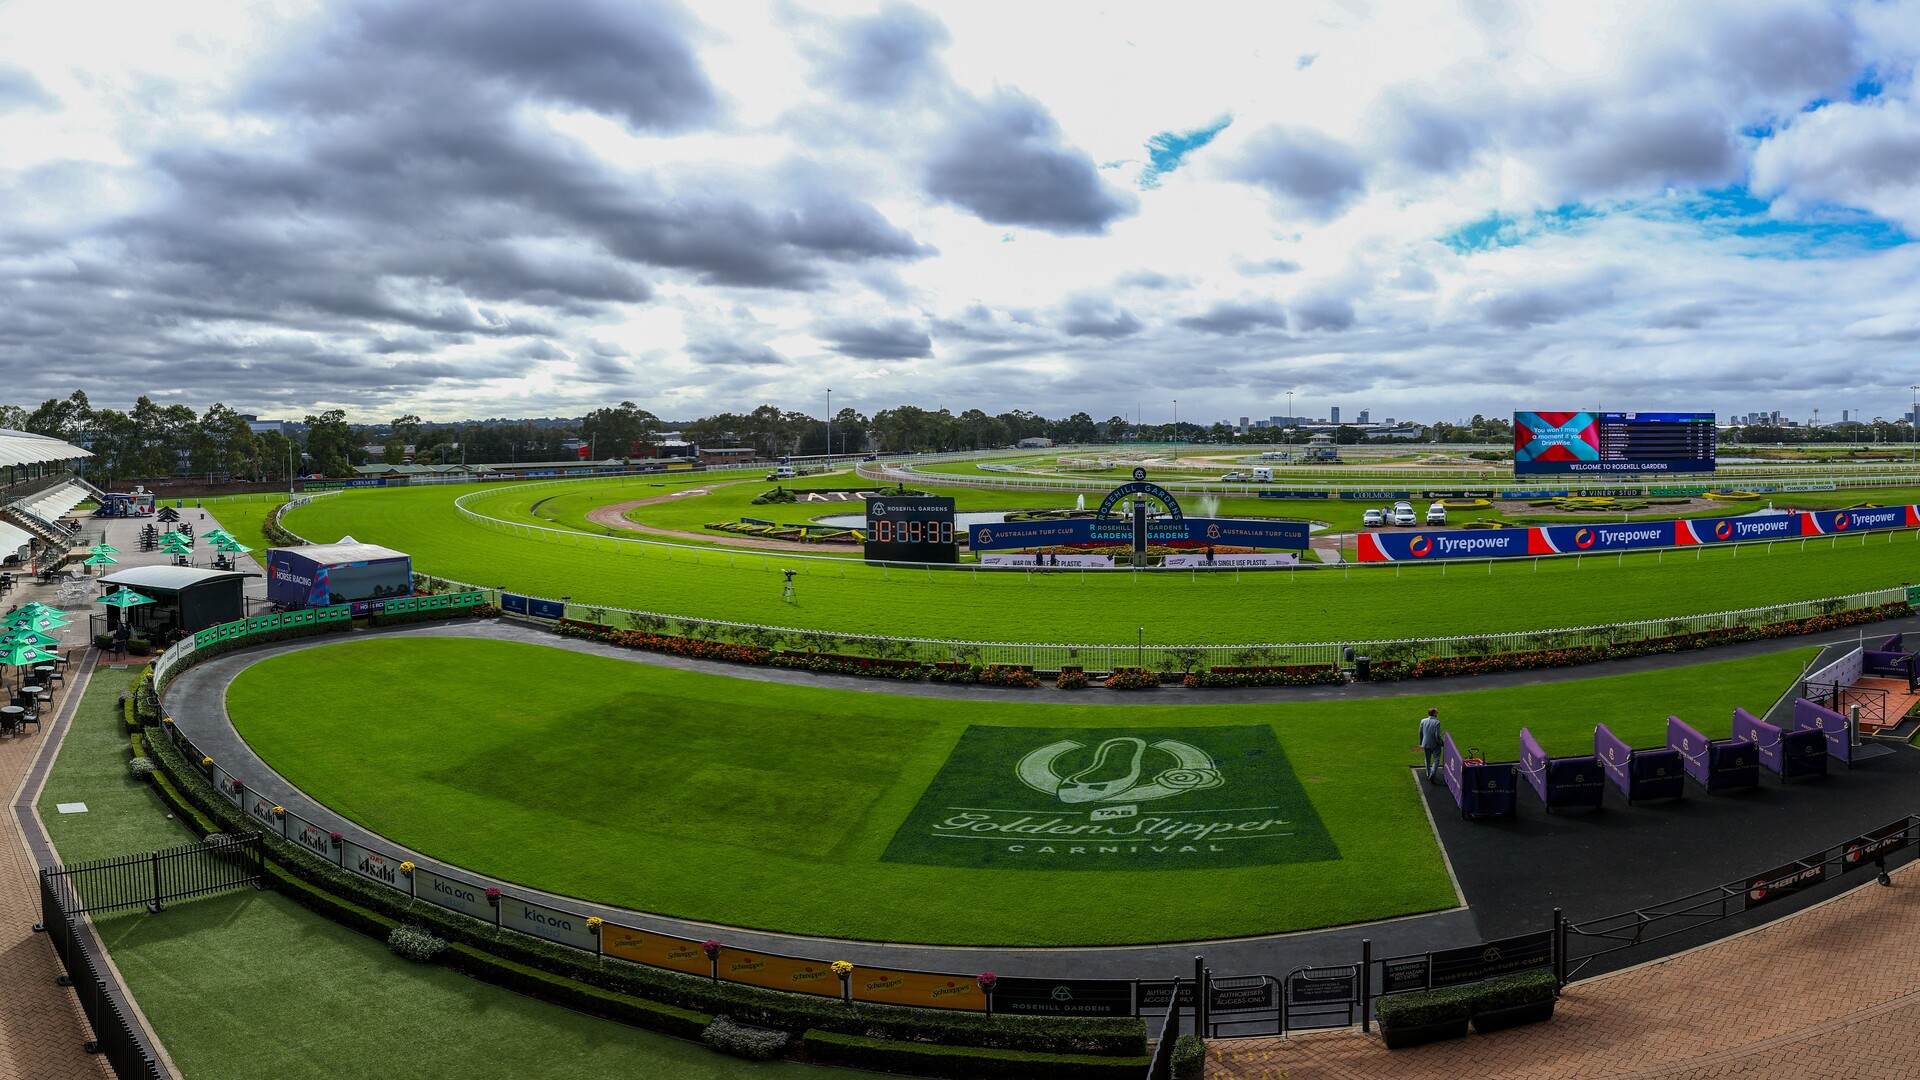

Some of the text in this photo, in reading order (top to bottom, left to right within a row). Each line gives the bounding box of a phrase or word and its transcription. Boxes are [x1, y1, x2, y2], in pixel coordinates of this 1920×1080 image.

[1098, 485, 1182, 521] ROSEHILL GARDENS
[1851, 512, 1895, 527] Tyrepower
[1736, 520, 1788, 535] Tyrepower
[1599, 528, 1661, 545] Tyrepower
[1438, 537, 1510, 553] Tyrepower
[276, 571, 292, 582] HORSE
[292, 575, 312, 587] RACING
[24, 651, 35, 659] TAB
[1844, 721, 1848, 729] 2
[254, 803, 275, 826] Asahi
[932, 812, 1292, 840] Golden Slipper
[299, 830, 327, 854] Asahi
[1008, 845, 1224, 854] CARNIVAL
[359, 858, 395, 884] Asahi
[434, 879, 475, 903] kia ora
[444, 897, 465, 909] stud
[524, 907, 571, 931] kia ora
[536, 925, 560, 938] stud
[614, 939, 643, 948] Schweppes
[668, 950, 698, 959] Schweppes
[731, 962, 764, 971] Schweppes
[1439, 956, 1544, 982] AUSTRALIAN TURF CLUB
[792, 971, 827, 981] Schweppes
[866, 979, 902, 991] Schweppes
[933, 985, 970, 997] Schweppes
[1219, 990, 1263, 998] AUTHORISED
[1012, 1003, 1060, 1011] ROSEHILL
[1216, 997, 1246, 1005] ACCESS
